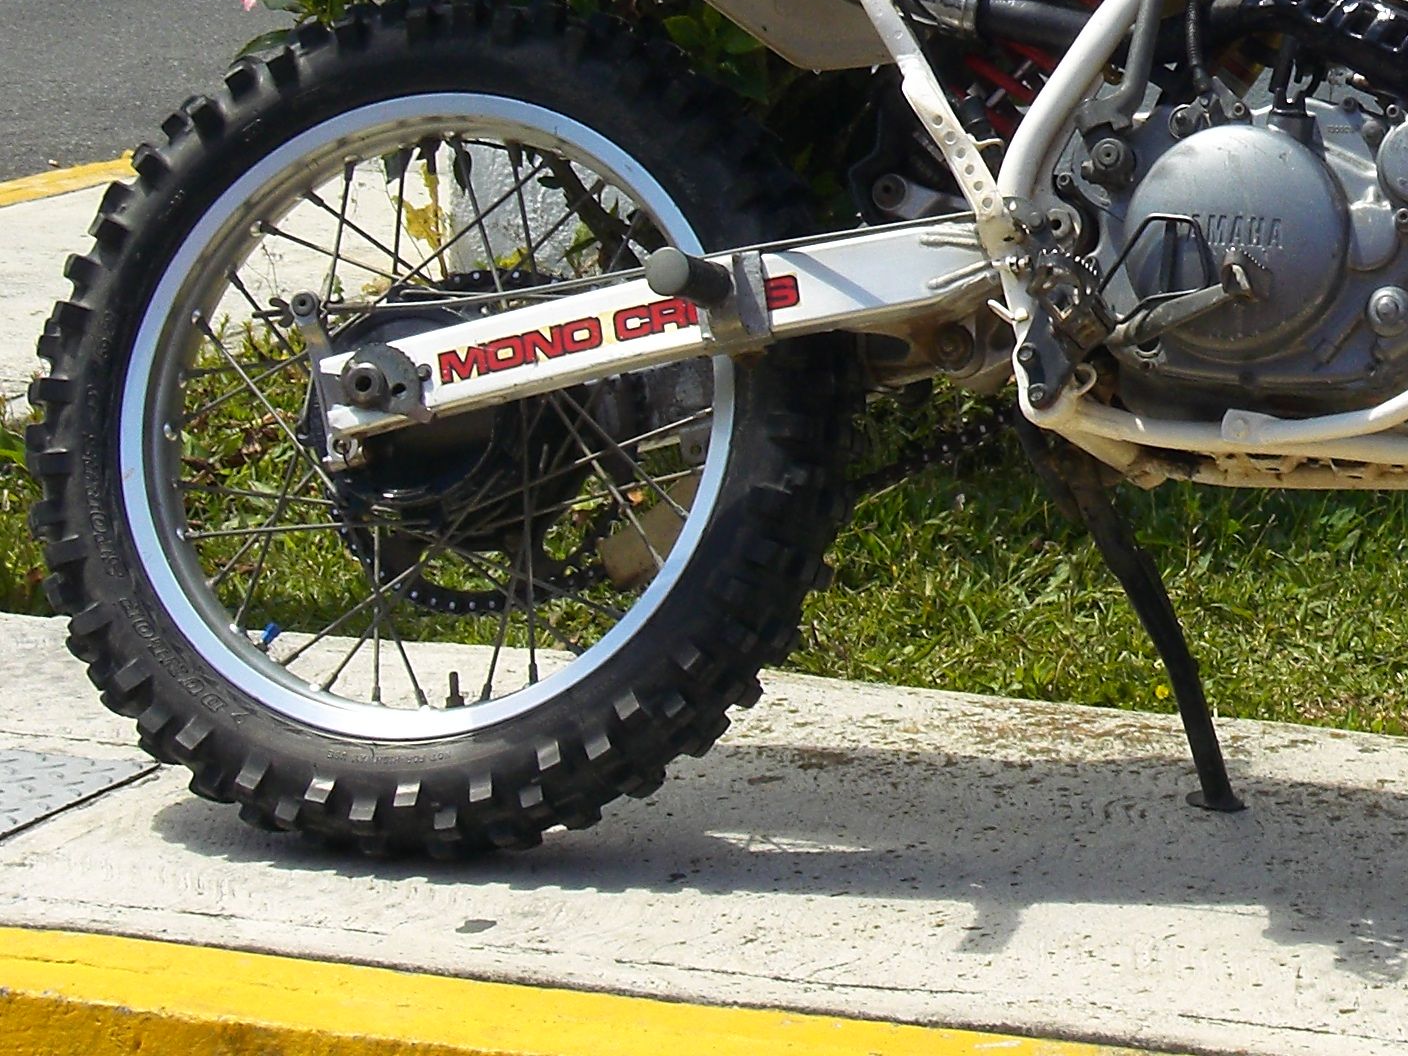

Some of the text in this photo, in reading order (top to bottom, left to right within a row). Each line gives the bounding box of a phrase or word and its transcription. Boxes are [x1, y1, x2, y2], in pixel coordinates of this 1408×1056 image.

[1174, 212, 1283, 247] AMAHA
[438, 274, 800, 385] MONO CRS
